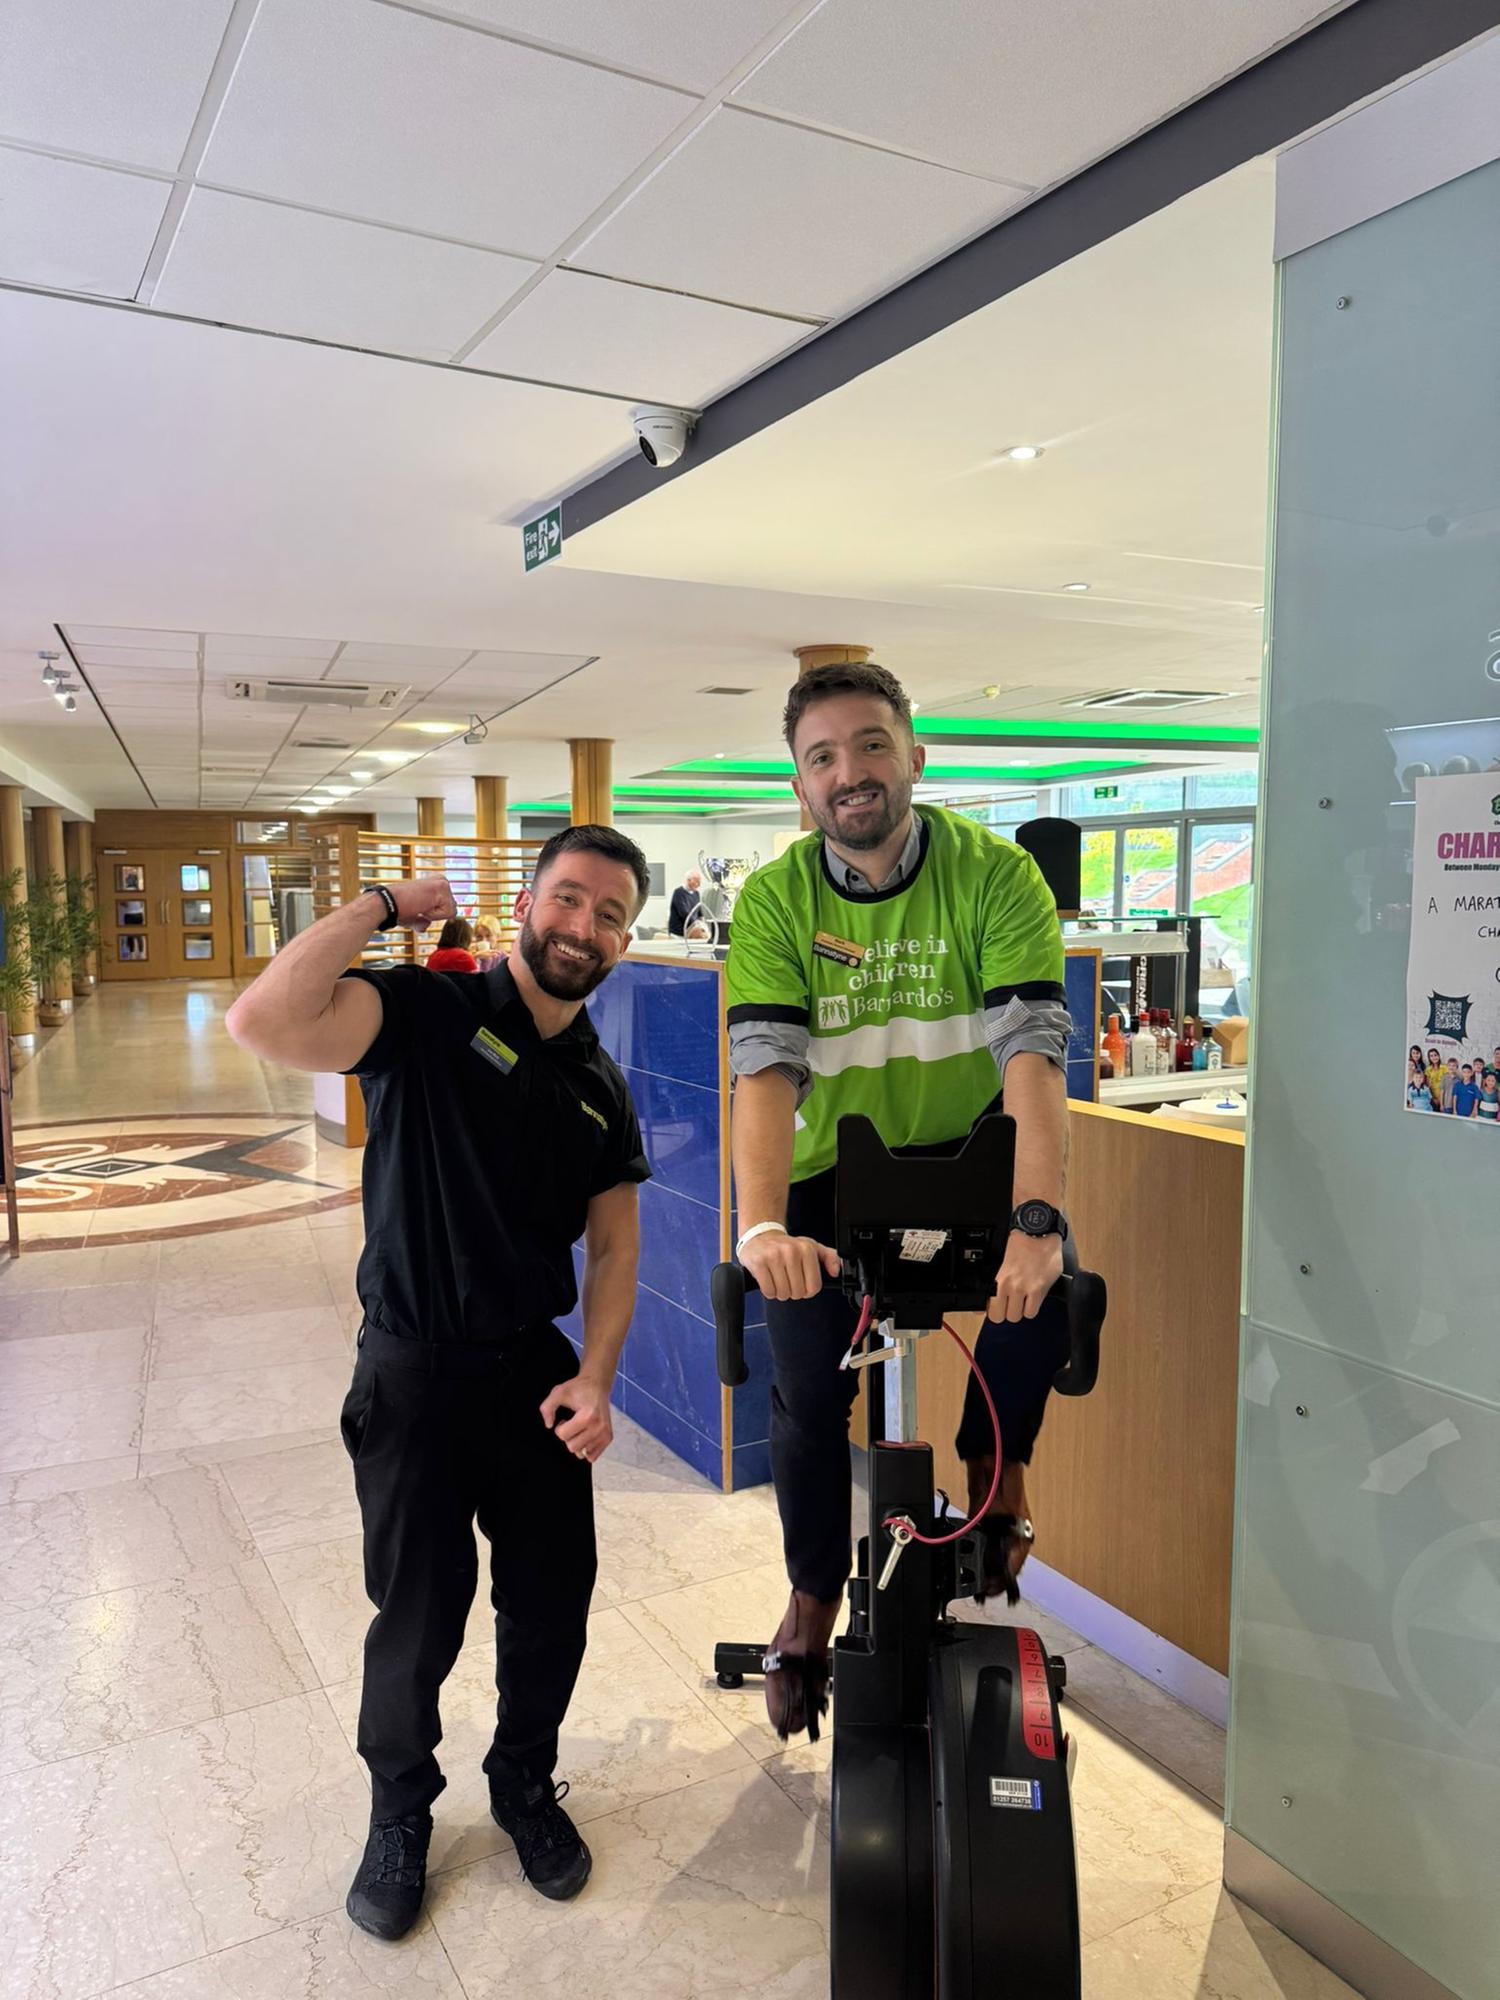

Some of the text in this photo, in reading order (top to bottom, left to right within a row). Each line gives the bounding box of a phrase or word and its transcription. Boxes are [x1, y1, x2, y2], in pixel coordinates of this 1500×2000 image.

[525, 531, 537, 546] Fire
[1437, 832, 1500, 859] CHAR
[1444, 863, 1472, 871] Between
[1428, 897, 1438, 914] A
[863, 939, 921, 962] elieve
[926, 935, 949, 953] in
[1034, 1733, 1049, 1748] 10
